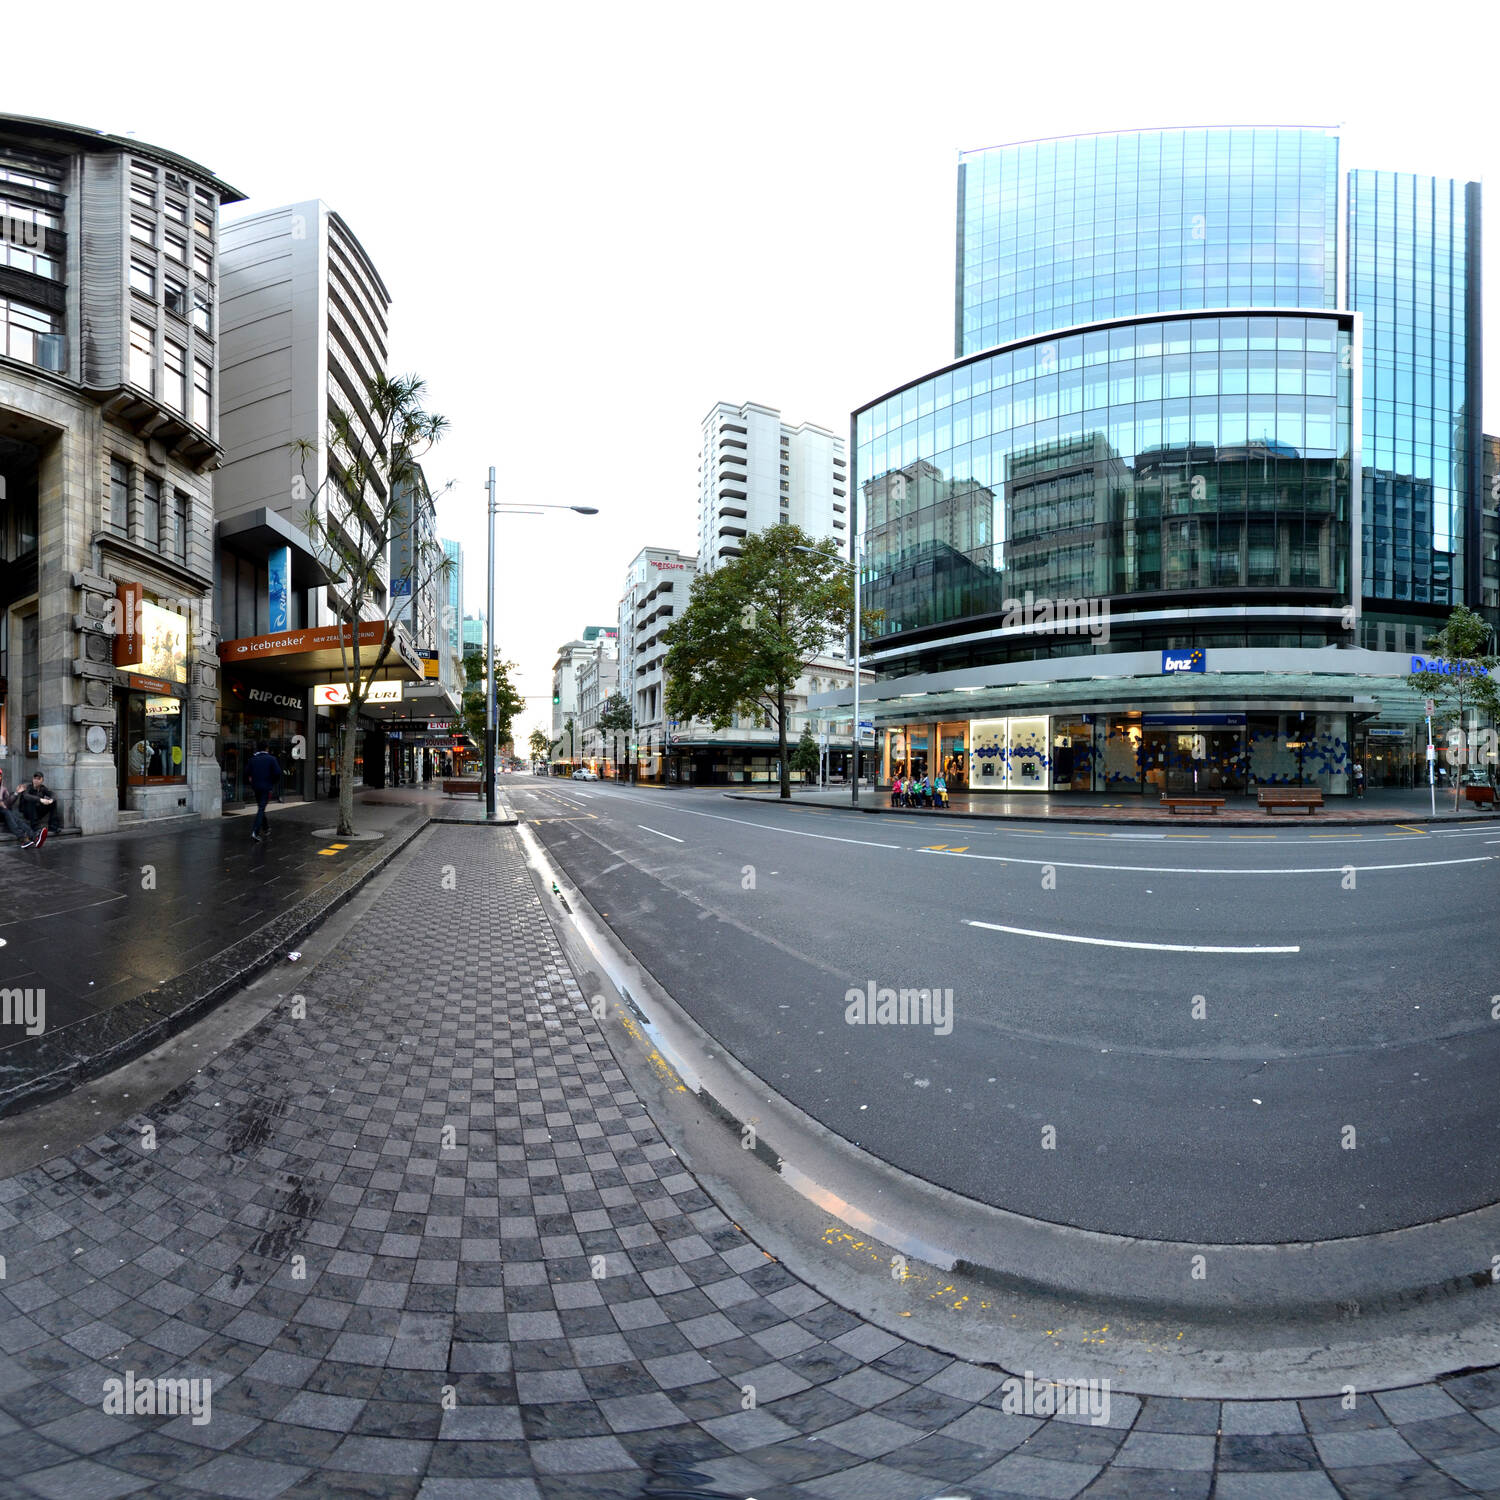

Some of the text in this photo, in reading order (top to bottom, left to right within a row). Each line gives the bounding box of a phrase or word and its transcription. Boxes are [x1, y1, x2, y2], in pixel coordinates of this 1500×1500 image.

[250, 636, 304, 651] icebreaker
[326, 633, 351, 642] ZEALND
[1165, 657, 1192, 671] bnz
[249, 688, 303, 710] RIP CURL
